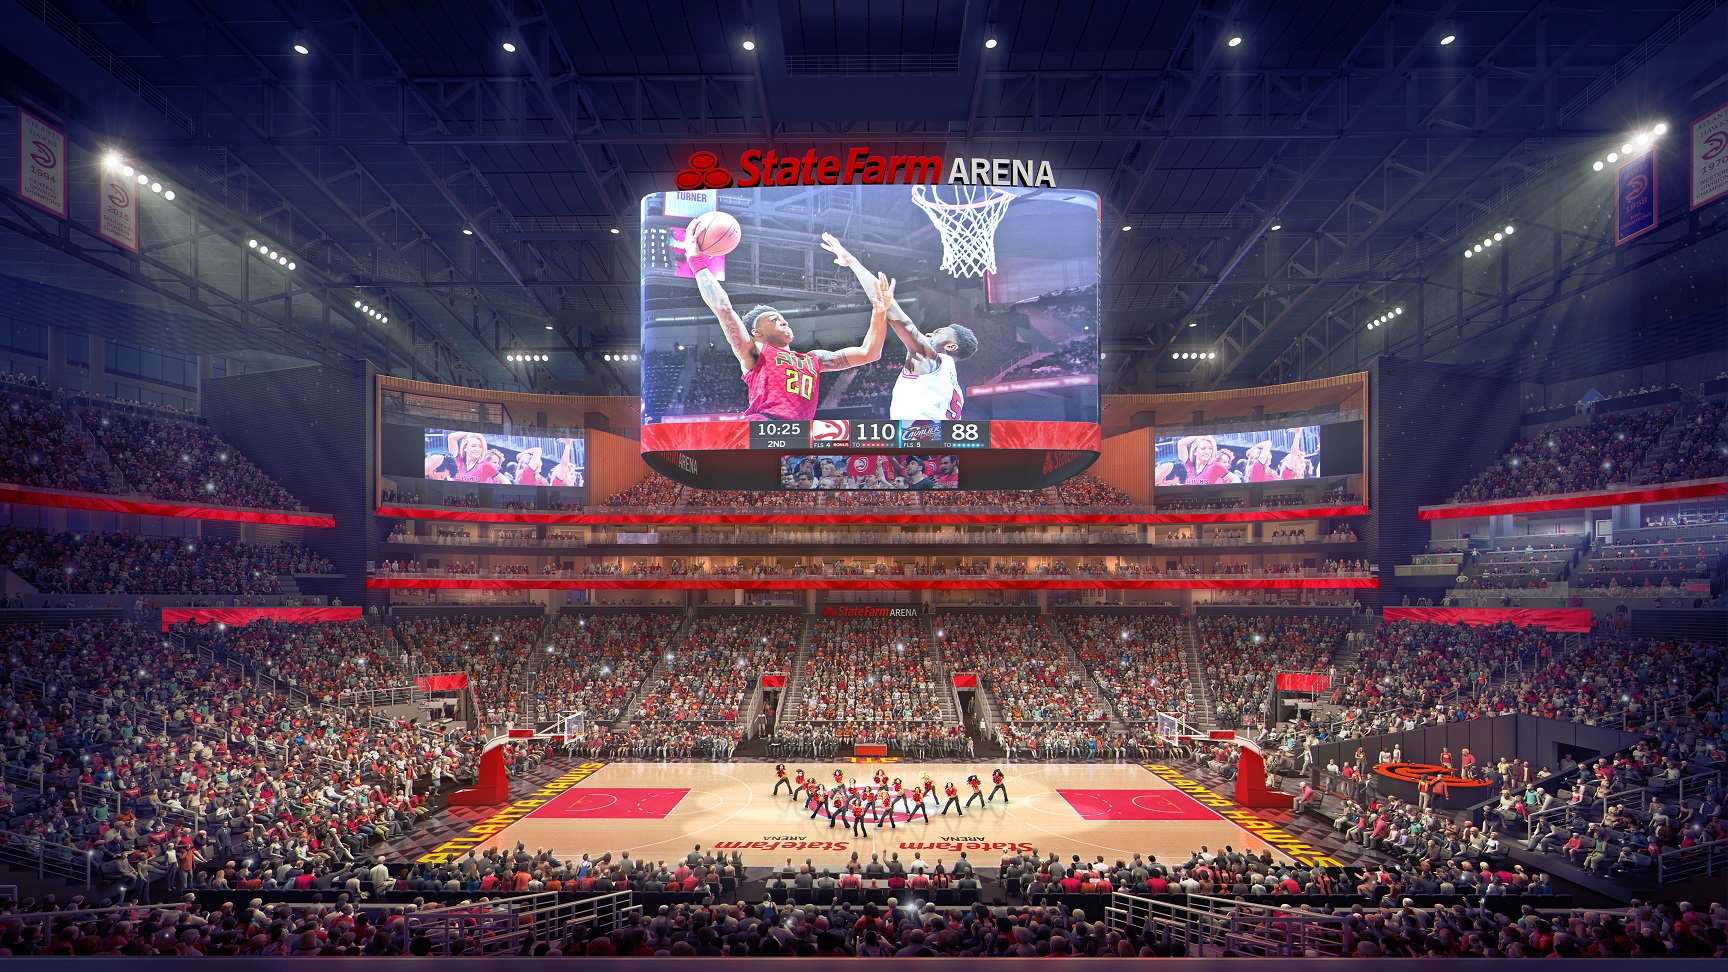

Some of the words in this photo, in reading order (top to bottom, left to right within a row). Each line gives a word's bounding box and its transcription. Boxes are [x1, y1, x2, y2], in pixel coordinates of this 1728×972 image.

[26, 118, 61, 141] ATLANTA
[29, 129, 57, 148] HAWKS
[948, 157, 1057, 188] ARENA
[1624, 163, 1649, 180] HAWKS
[1702, 155, 1728, 174] 1970
[30, 165, 56, 183] 1994
[29, 177, 57, 195] CENTRAL
[29, 184, 57, 200] DIVISION
[25, 187, 61, 208] CHAMPIONS
[676, 191, 707, 203] TURNER
[107, 205, 129, 221] 2015
[1620, 211, 1652, 231] CHAMPIONS
[1630, 211, 1642, 221] NBA
[103, 215, 133, 232] SOUTHEAST
[107, 222, 130, 237] DIVISION
[103, 225, 133, 243] CHAMPIONS
[775, 351, 818, 377] ATL
[785, 368, 812, 400] 20
[758, 423, 801, 436] 10:25
[857, 423, 895, 441] 110
[951, 424, 979, 441] 88
[767, 440, 786, 448] 2ND
[678, 452, 698, 476] ARENA
[889, 608, 917, 617] ARENA
[1144, 763, 1235, 807] ATLANTA
[416, 798, 549, 864] ATLANTA
[530, 762, 606, 797] HAWKS
